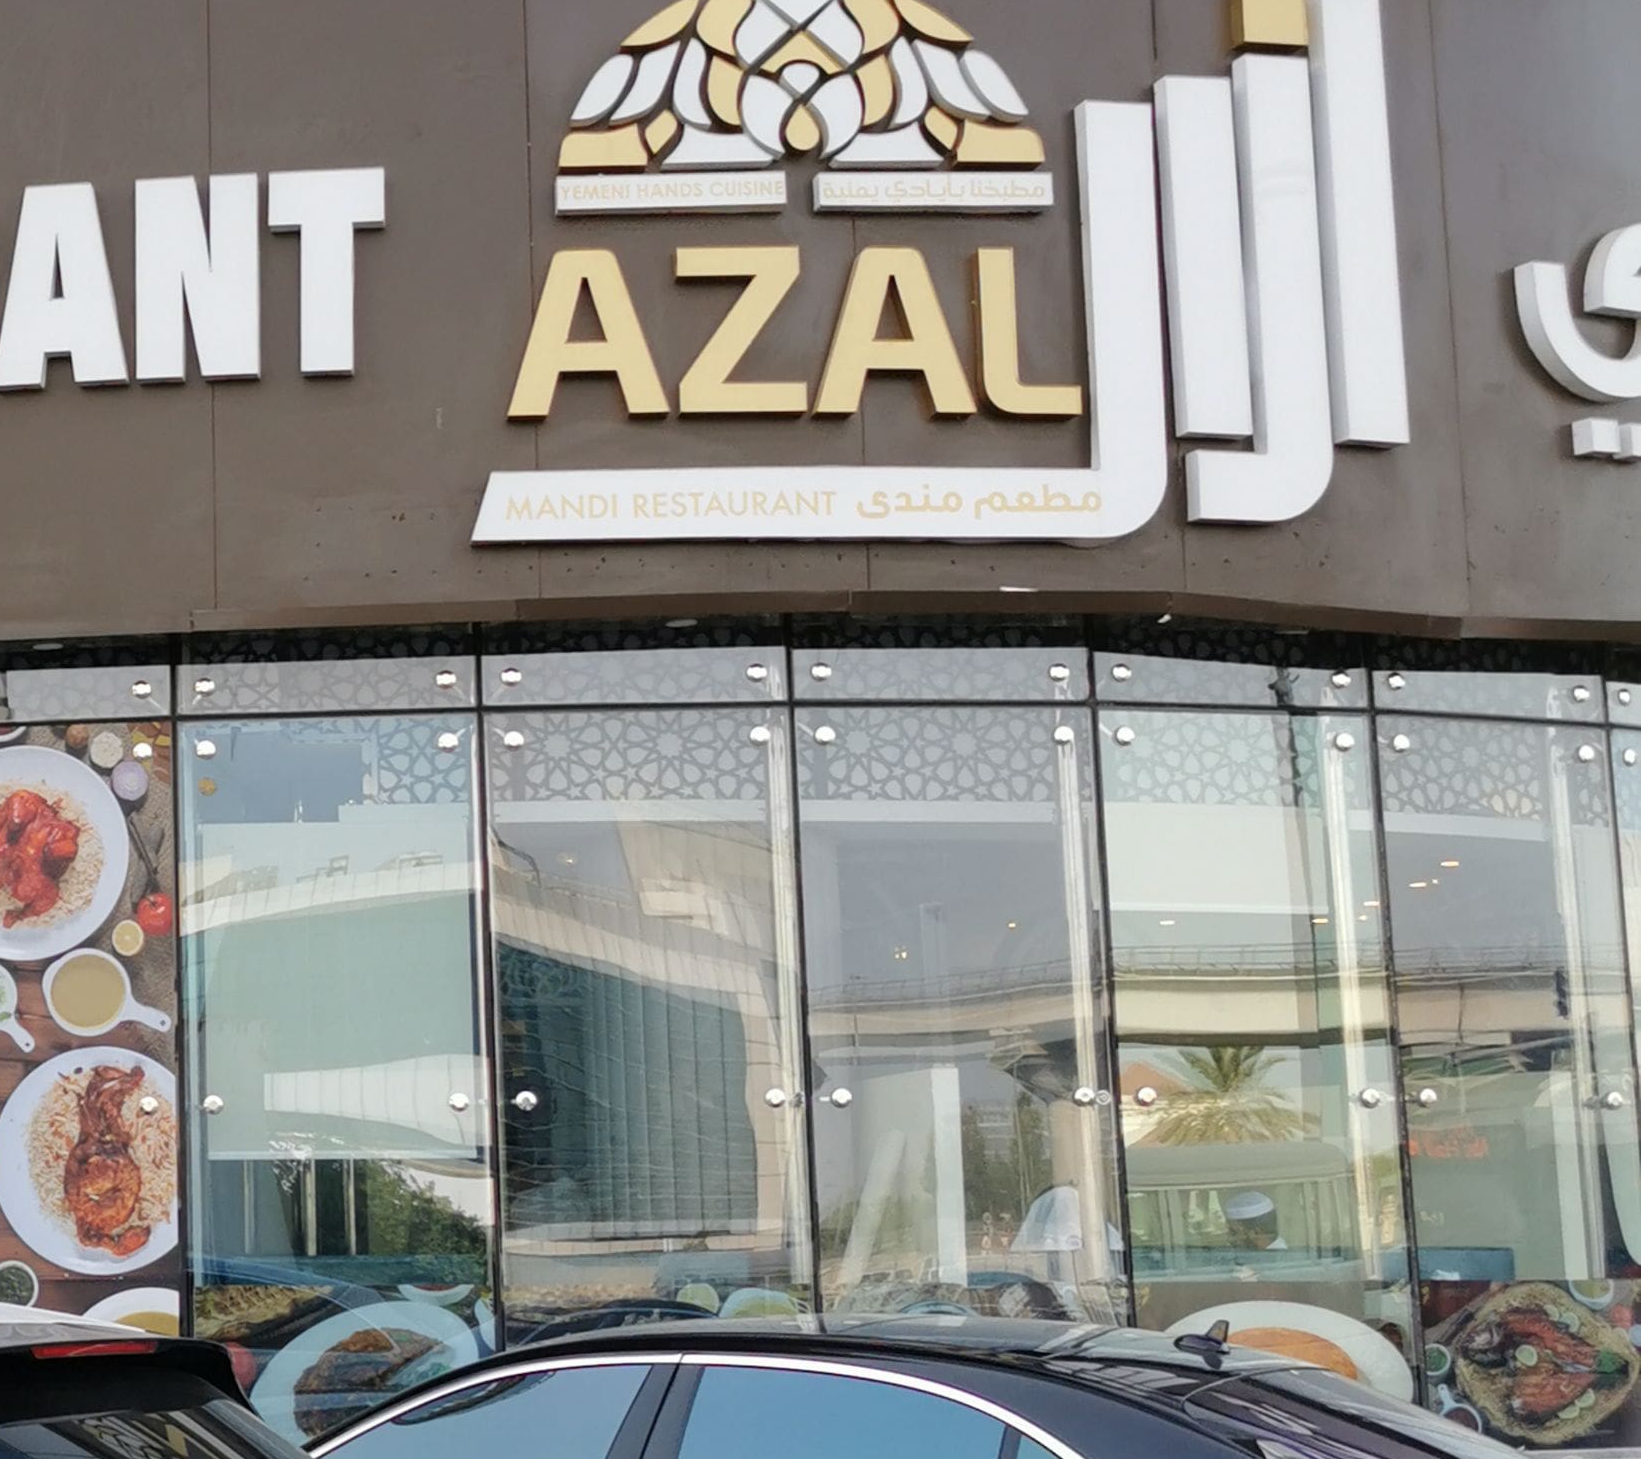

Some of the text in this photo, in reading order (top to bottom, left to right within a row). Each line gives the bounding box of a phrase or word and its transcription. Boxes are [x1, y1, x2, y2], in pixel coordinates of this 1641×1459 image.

[561, 180, 783, 201] YEMENI HANDS CUISINE
[506, 246, 1083, 421] AZAL
[505, 491, 836, 521] MANDI RESTAURANT
[975, 484, 1103, 520] مطعم
